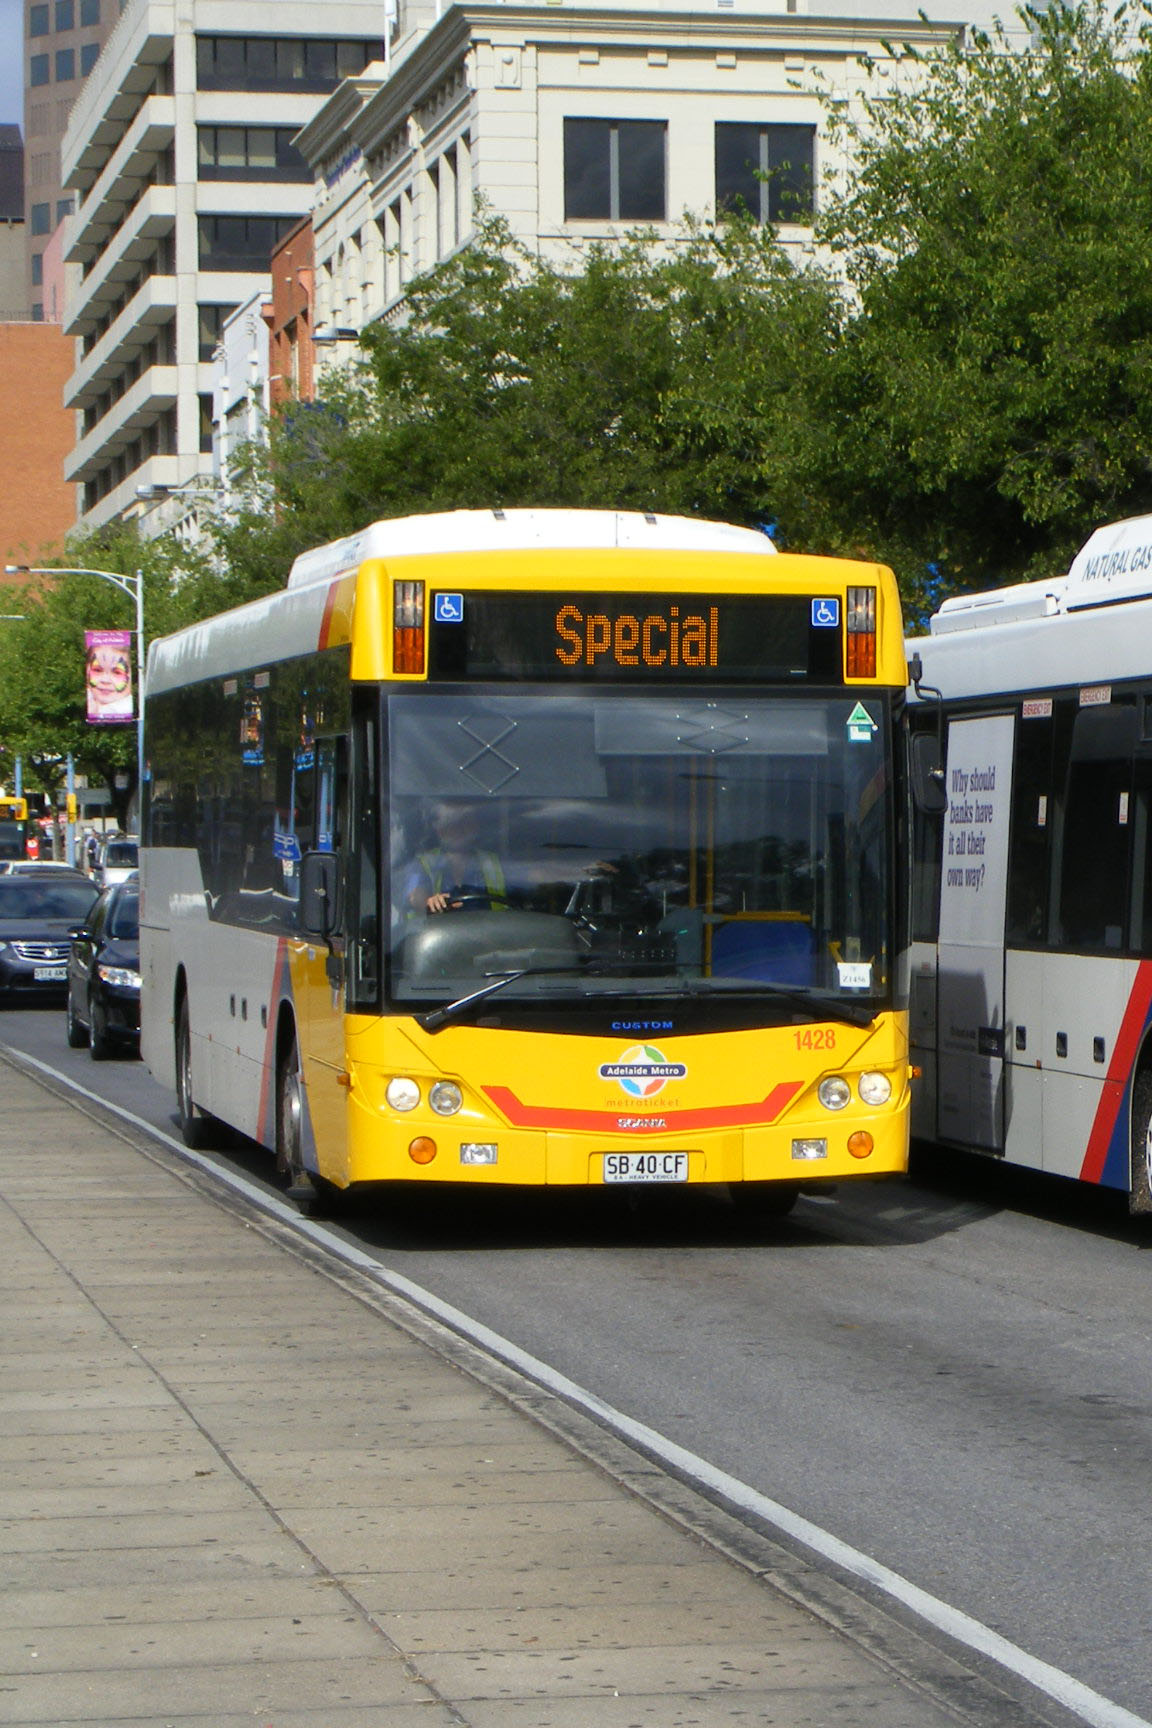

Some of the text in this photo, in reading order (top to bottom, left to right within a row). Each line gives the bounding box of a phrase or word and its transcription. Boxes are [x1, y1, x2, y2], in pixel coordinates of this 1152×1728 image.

[1082, 549, 1128, 582] NATURAL
[555, 604, 719, 666] Special
[951, 766, 996, 797] Why should
[950, 800, 993, 824] banks have
[948, 831, 986, 856] it all their
[947, 863, 985, 892] own way?
[611, 1020, 674, 1030] CUSTOM
[793, 1028, 836, 1051] 1428
[607, 1065, 679, 1076] Adelaide Metro
[605, 1097, 680, 1107] metroticket
